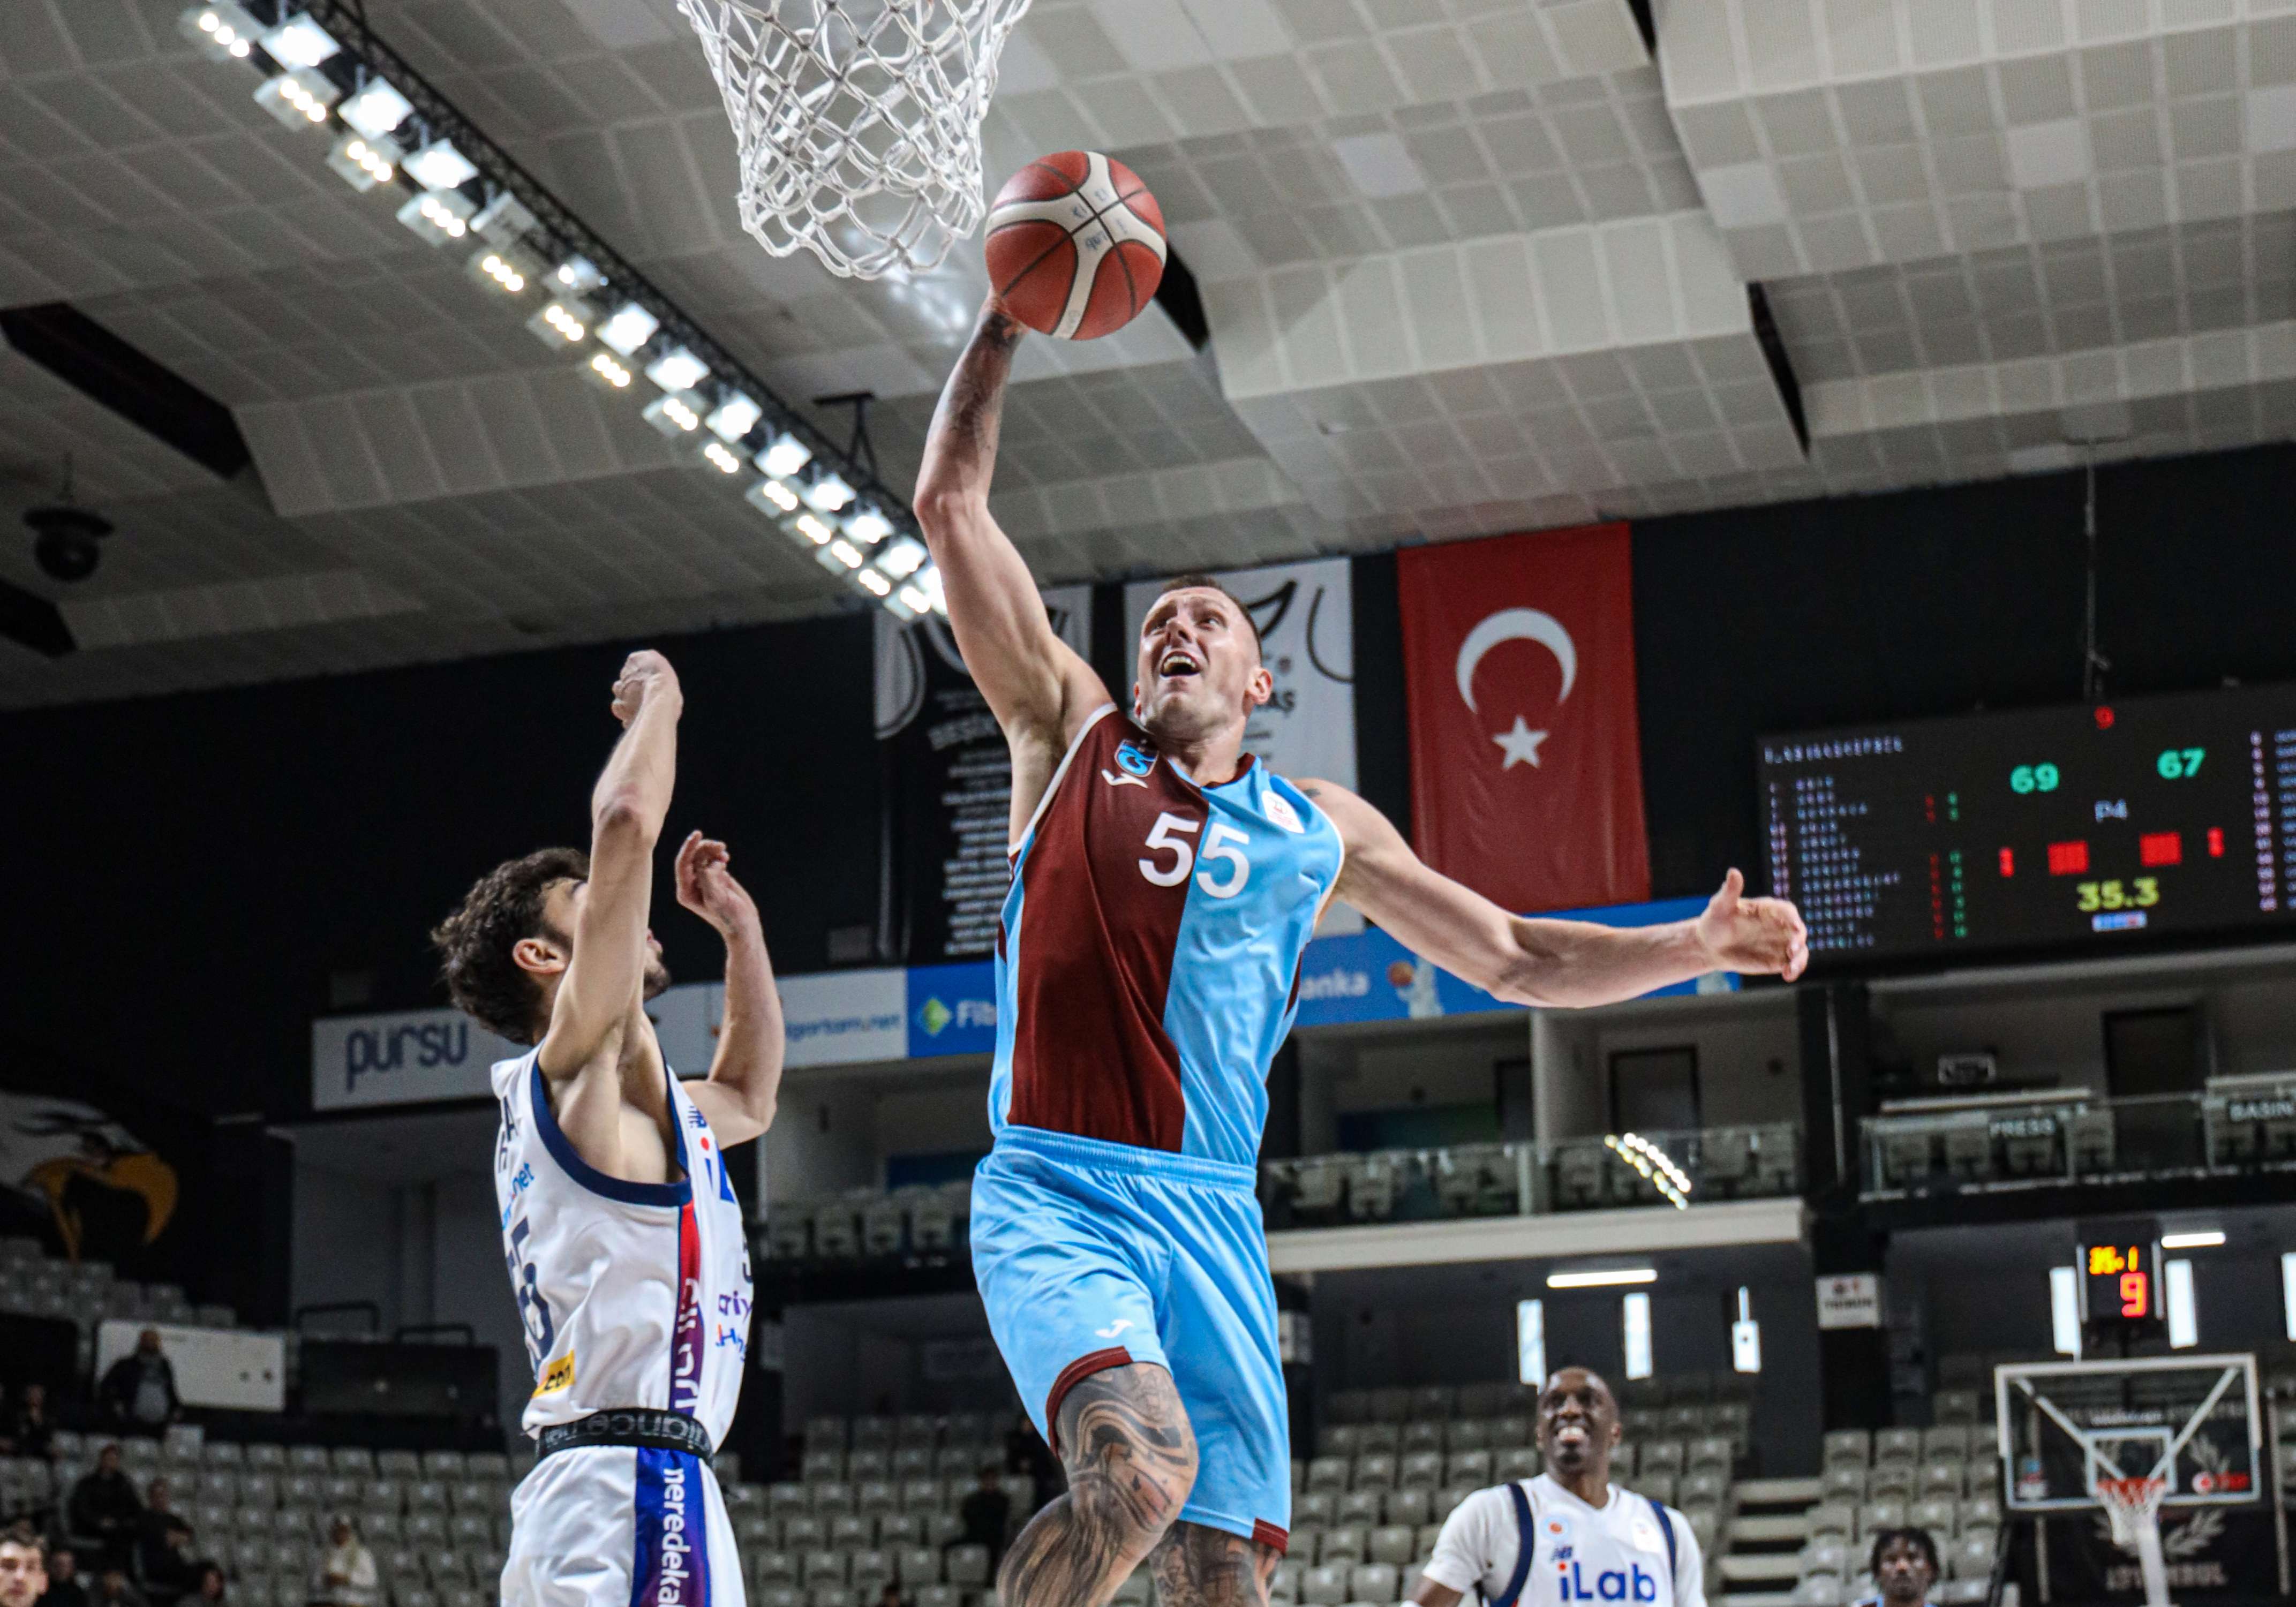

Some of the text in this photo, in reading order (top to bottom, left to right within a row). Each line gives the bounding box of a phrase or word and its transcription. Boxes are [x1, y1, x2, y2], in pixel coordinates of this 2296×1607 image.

[2009, 764, 2060, 795] 69
[2156, 746, 2207, 780] 67
[1139, 811, 1250, 899] 55
[2076, 877, 2161, 912] 35.3
[2120, 1271, 2147, 1318] 9
[1557, 1560, 1656, 1602] iLab
